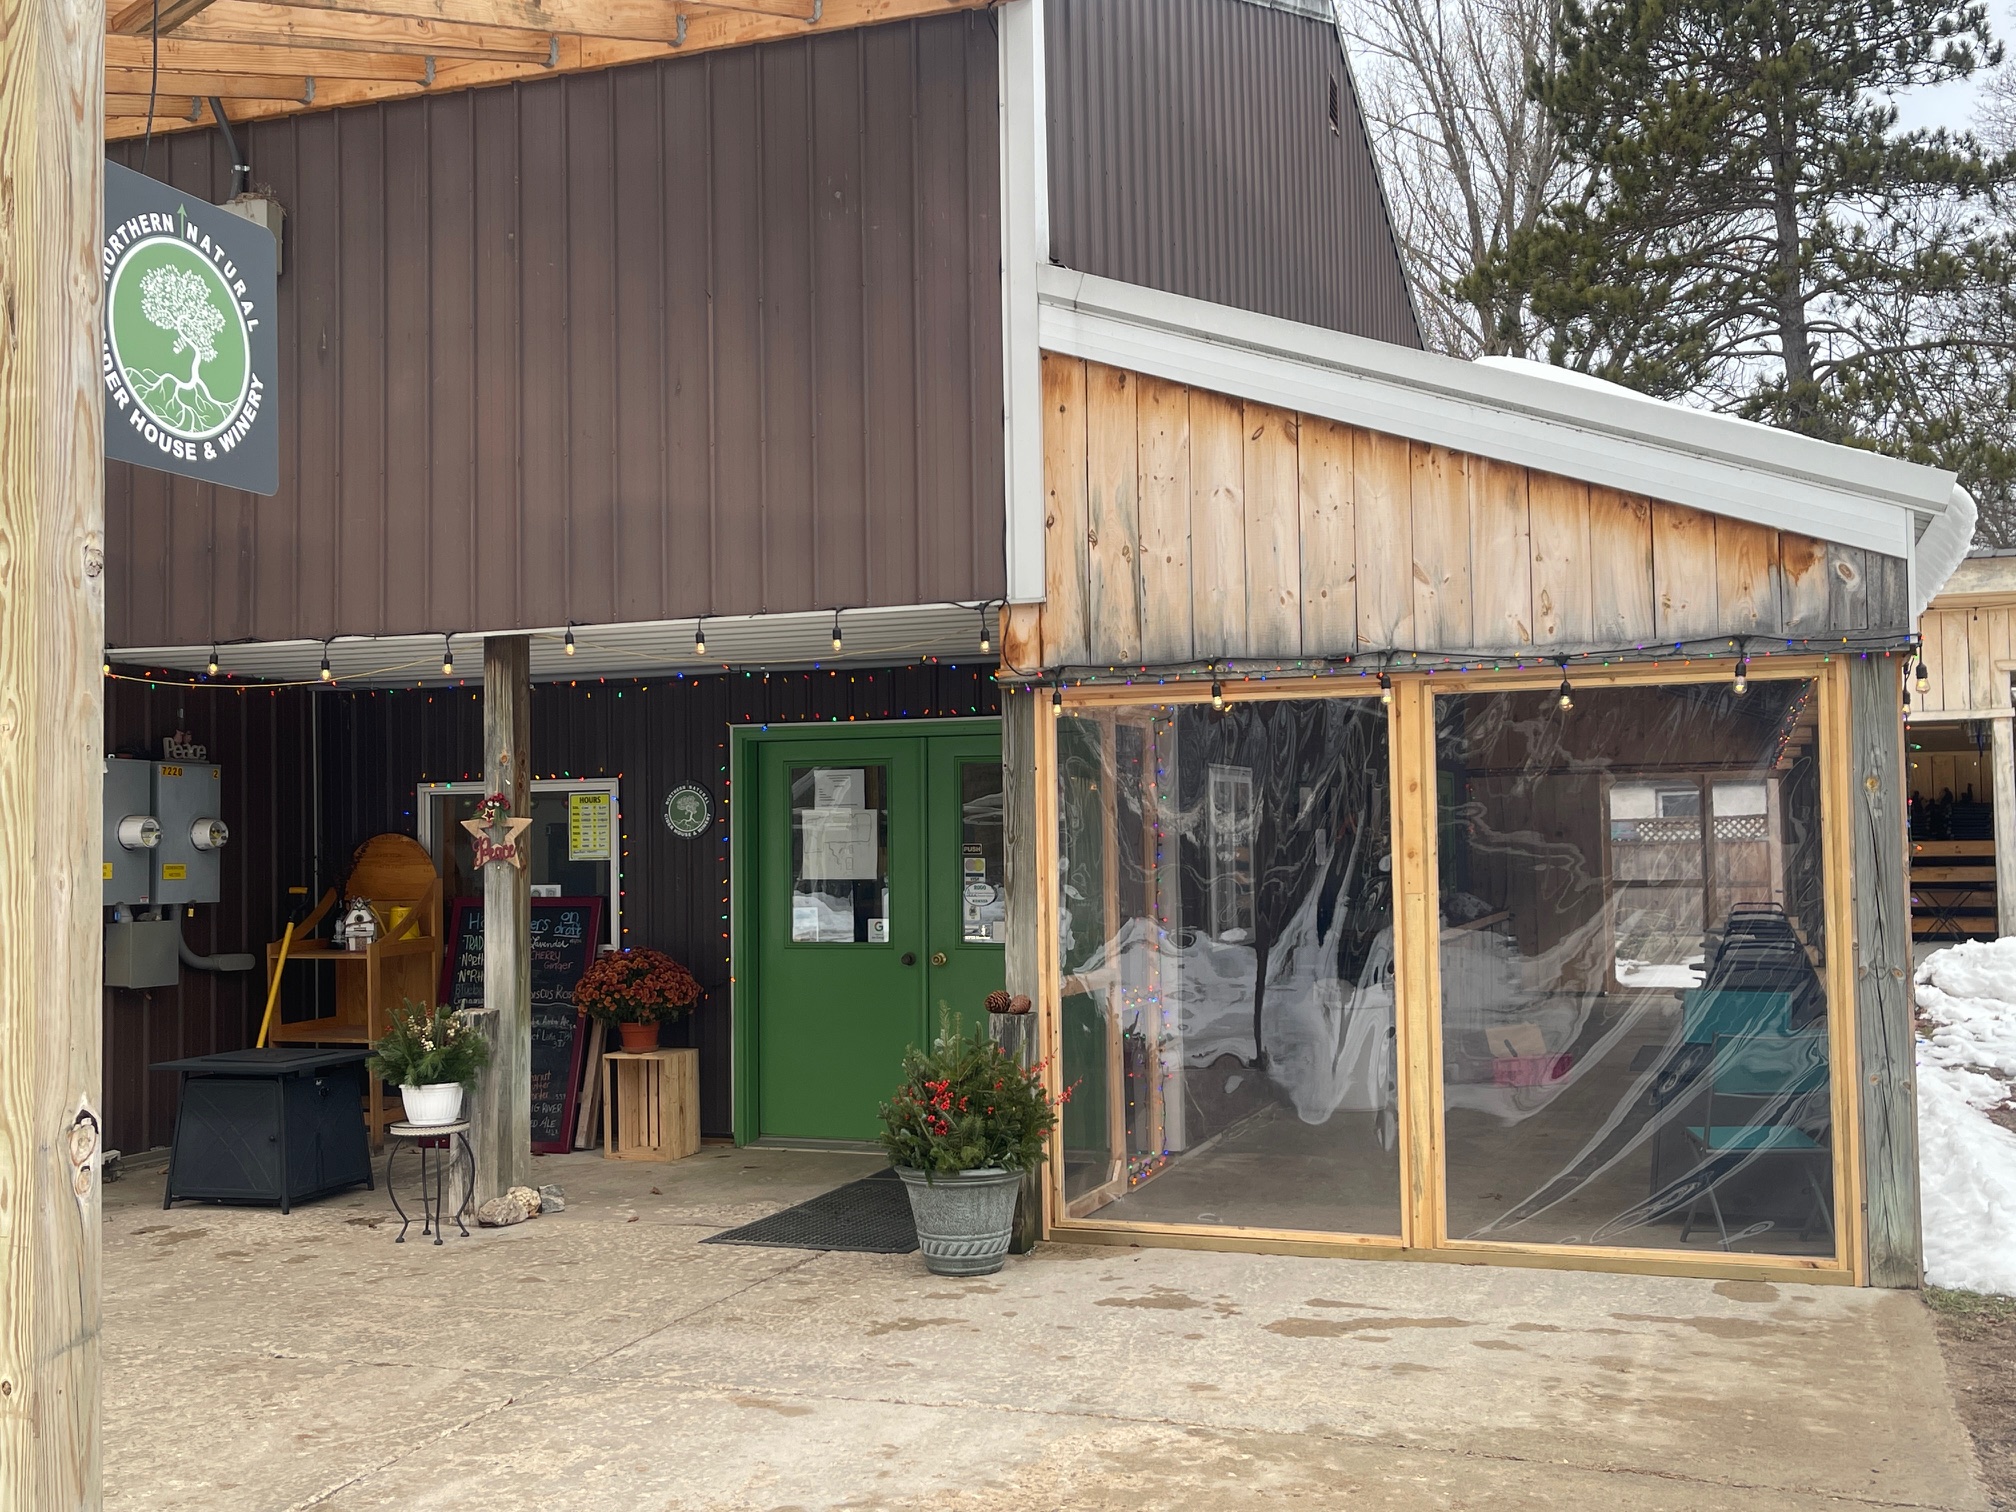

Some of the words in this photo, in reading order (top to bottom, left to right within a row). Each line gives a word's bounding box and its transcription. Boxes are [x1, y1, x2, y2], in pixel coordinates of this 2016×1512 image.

[186, 221, 260, 333] NATURAL
[129, 408, 198, 461] HOUSE
[203, 441, 218, 460] &
[218, 372, 264, 453] WINERY
[162, 737, 207, 760] Peace
[162, 766, 183, 777] 7220
[213, 769, 219, 779] 2
[579, 796, 602, 804] HOURS
[472, 836, 515, 867] Peace
